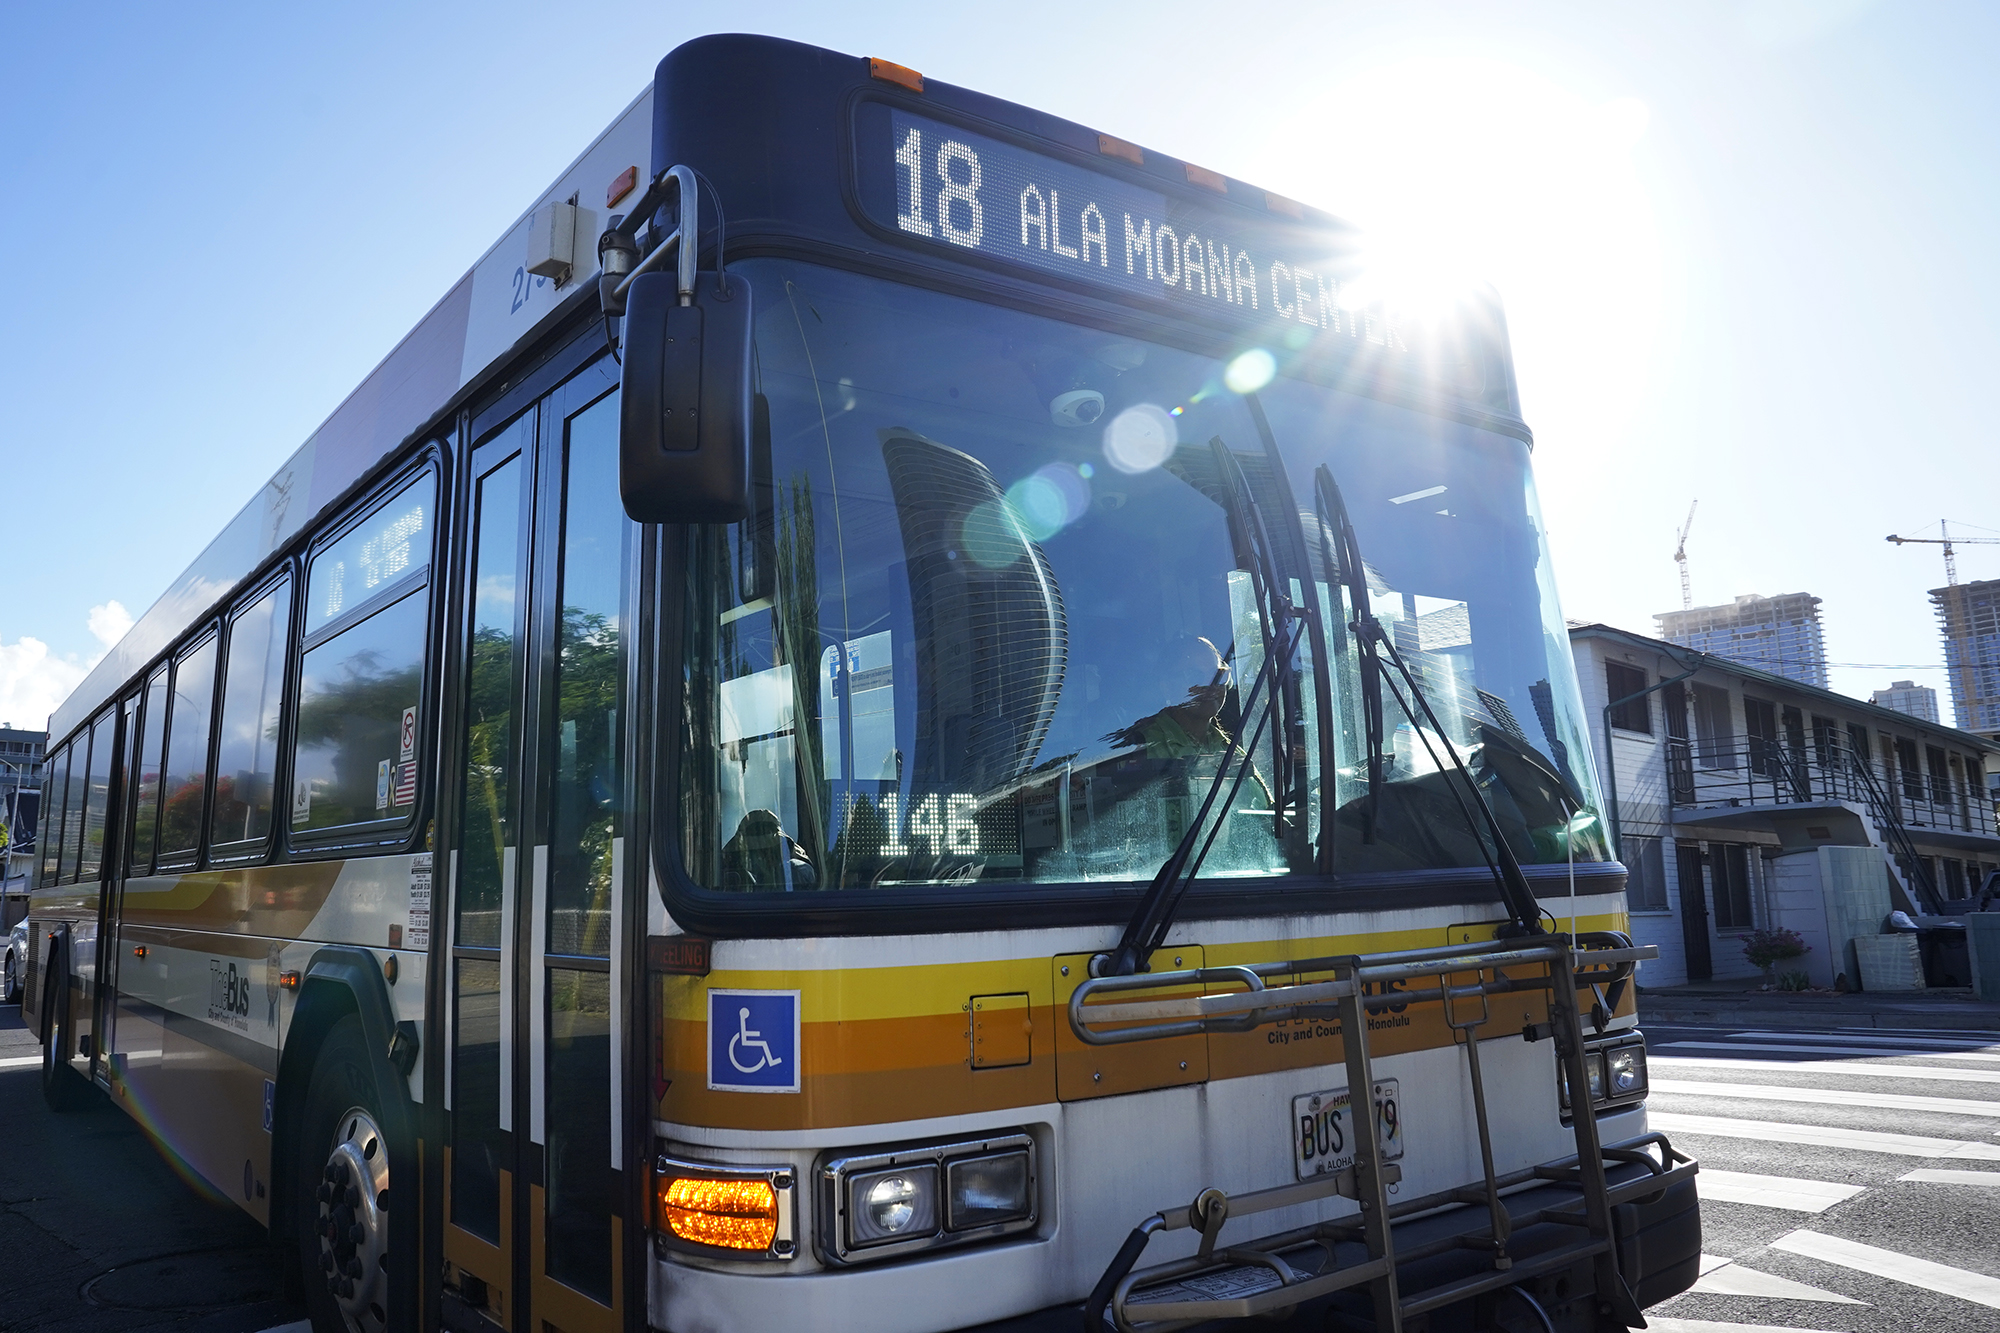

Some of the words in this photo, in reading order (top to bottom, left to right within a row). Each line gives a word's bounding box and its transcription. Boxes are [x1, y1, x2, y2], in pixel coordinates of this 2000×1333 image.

[896, 127, 984, 249] 18
[1020, 182, 1109, 268] ALA
[1123, 212, 1259, 311] MOANA
[878, 792, 980, 857] 146
[650, 944, 703, 966] KEELING
[210, 960, 249, 1017] TheBus
[1267, 1031, 1290, 1045] City
[1293, 1027, 1312, 1041] and
[1315, 1025, 1342, 1038] Coun
[1367, 1016, 1410, 1031] Honolulu
[1301, 1110, 1344, 1160] BUS
[1327, 1156, 1353, 1170] ALOHA
